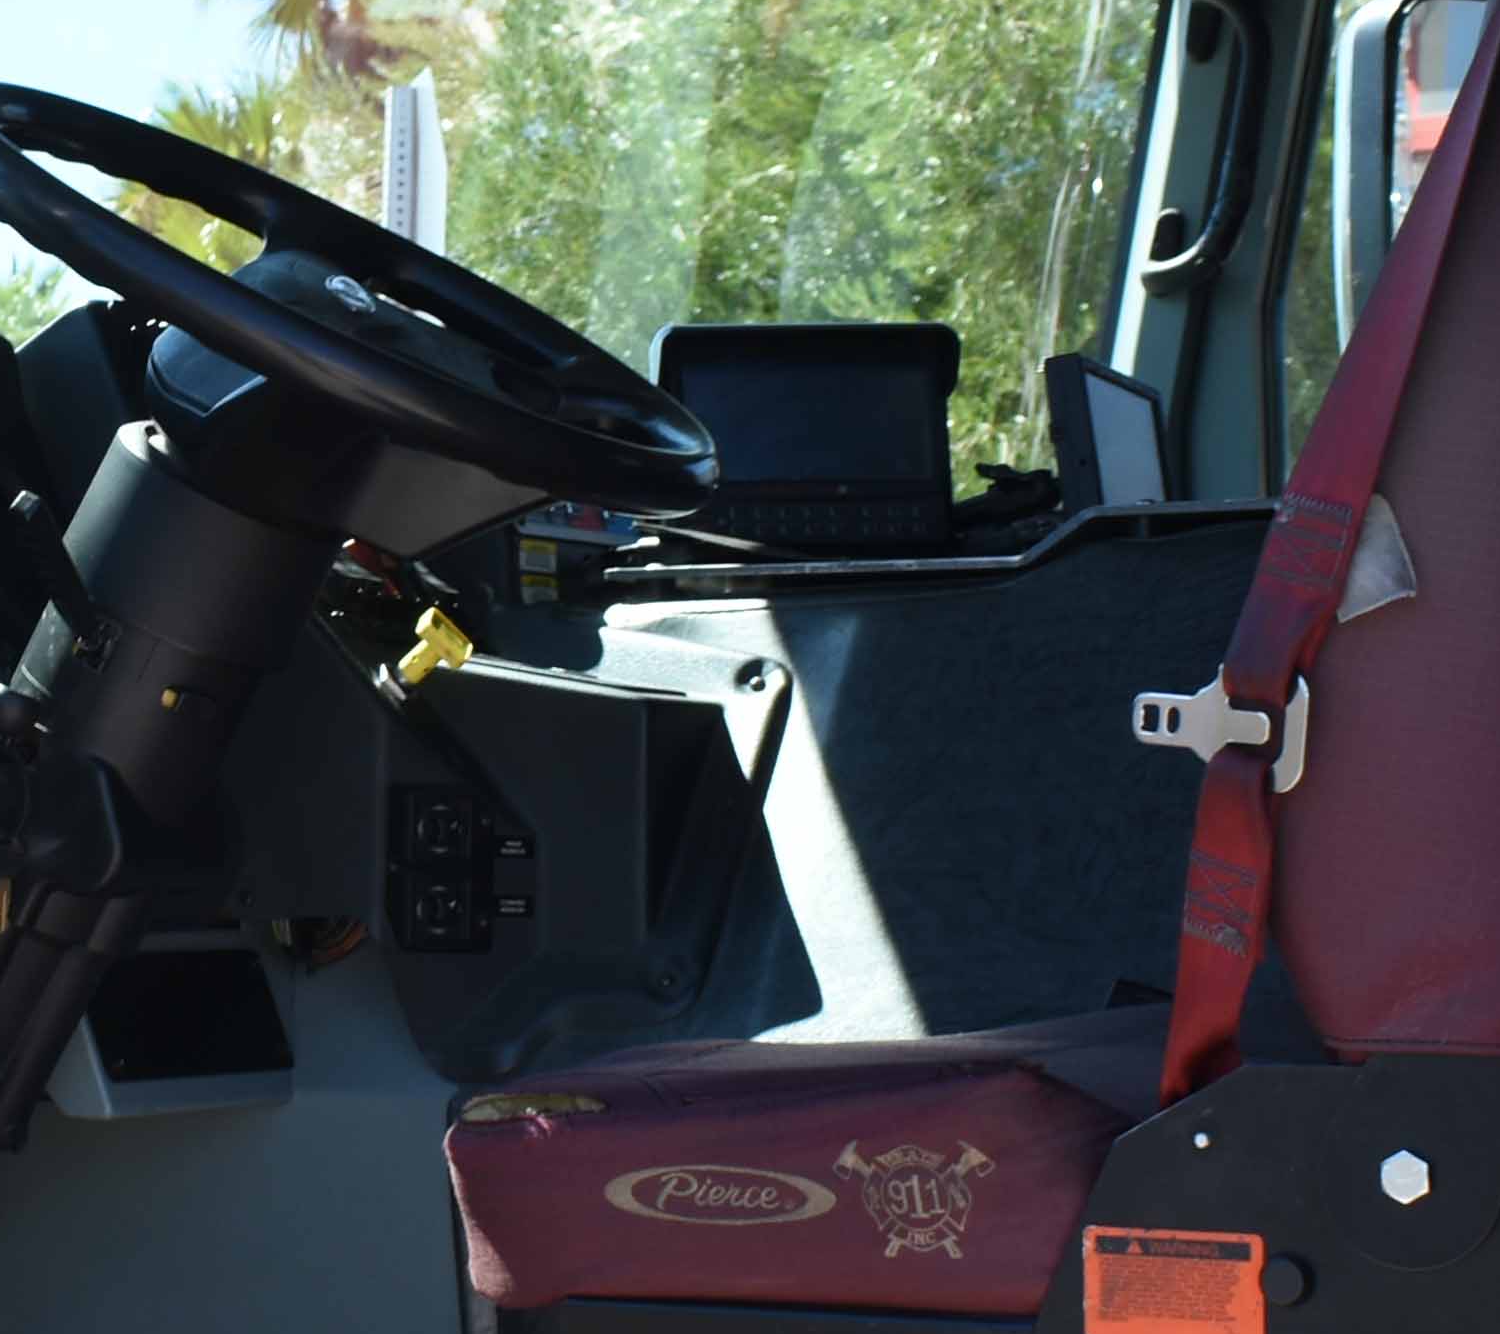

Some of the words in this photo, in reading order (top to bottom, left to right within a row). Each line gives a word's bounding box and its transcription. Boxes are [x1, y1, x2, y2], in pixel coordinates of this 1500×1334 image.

[657, 1172, 781, 1210] Pierce
[888, 1174, 945, 1219] 911
[907, 1231, 937, 1244] INC
